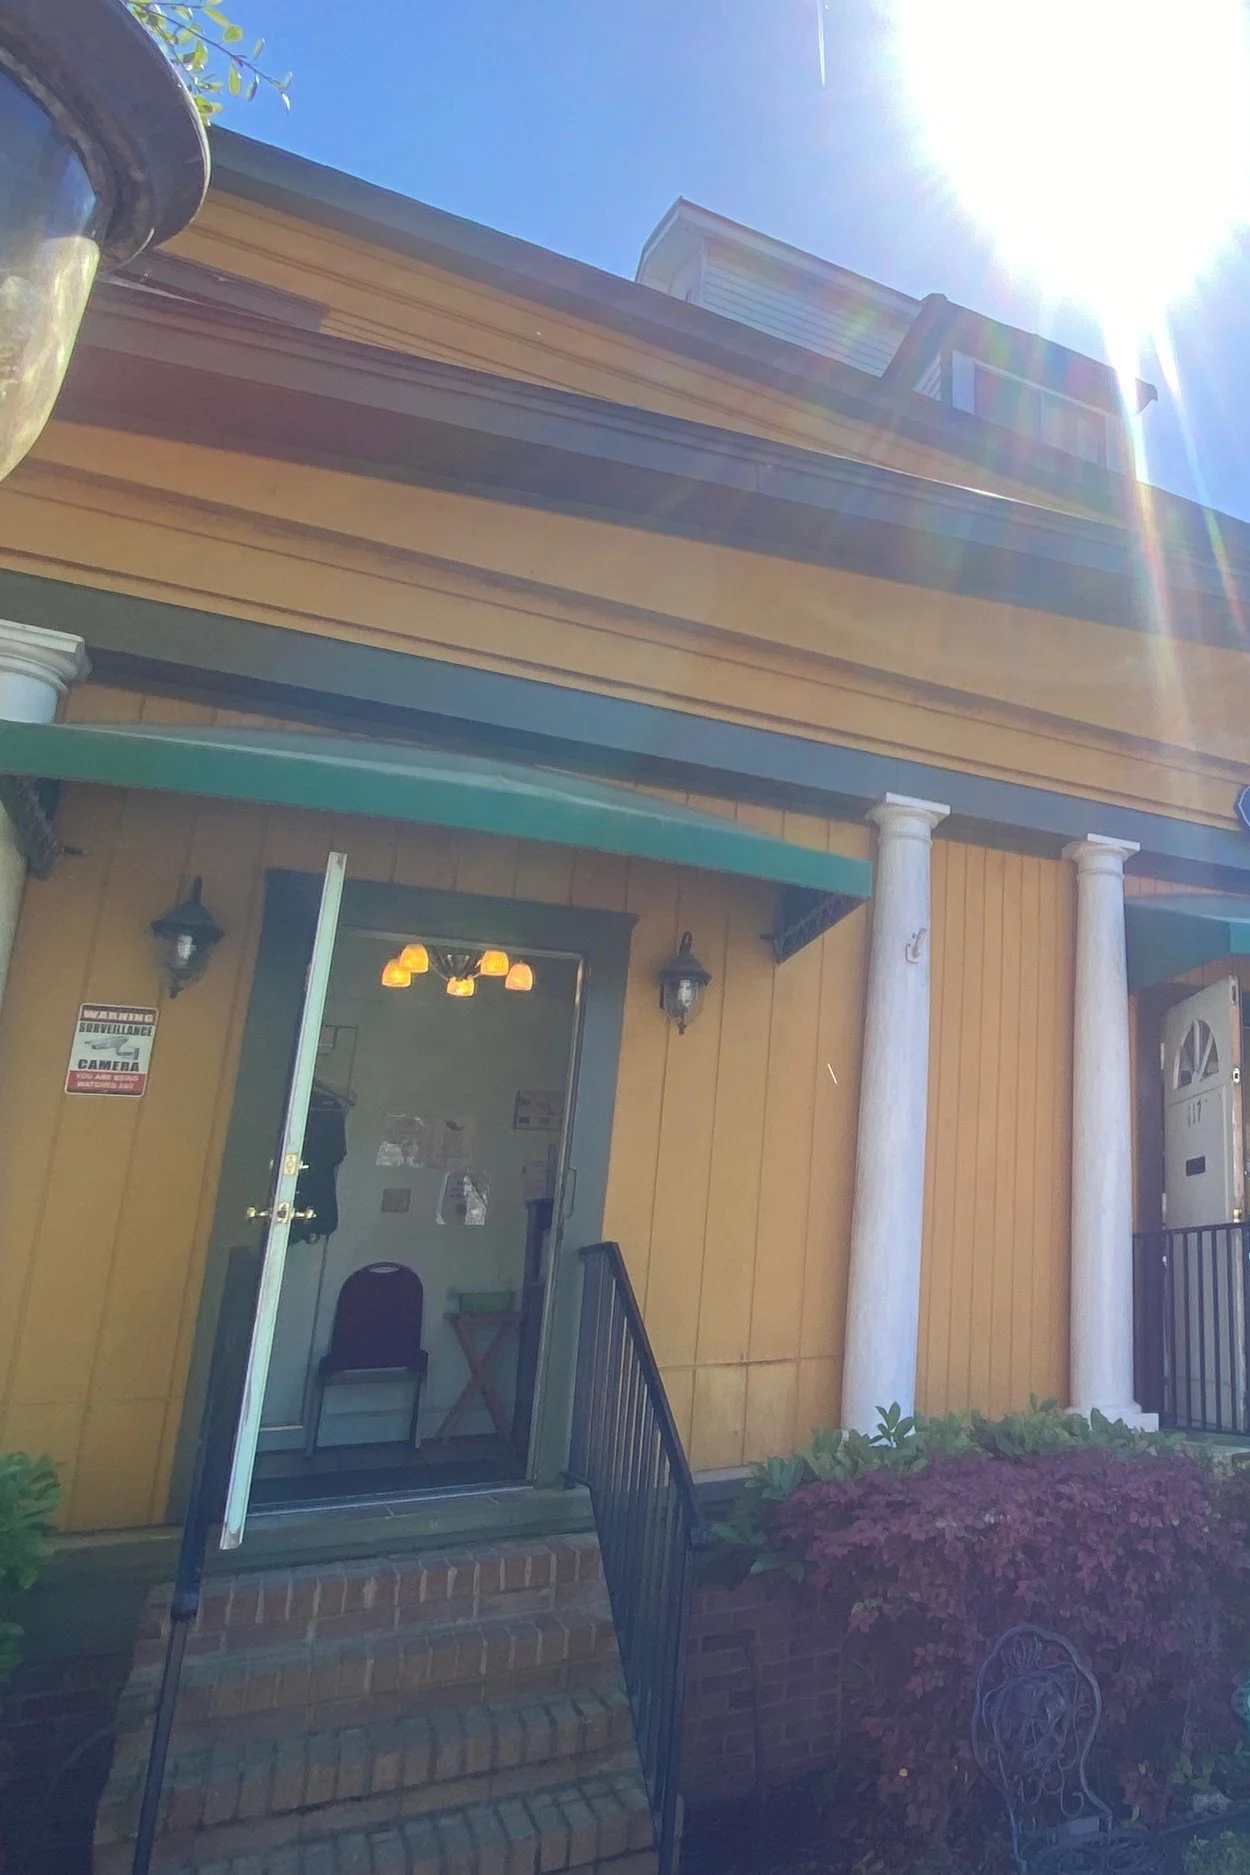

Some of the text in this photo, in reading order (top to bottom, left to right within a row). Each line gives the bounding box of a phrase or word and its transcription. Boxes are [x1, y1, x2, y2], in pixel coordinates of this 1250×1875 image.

[83, 1010, 153, 1022] WARNING
[78, 1022, 152, 1037] SURVEILLANCE
[77, 1059, 140, 1072] CAMERA
[76, 1072, 94, 1080] YOU
